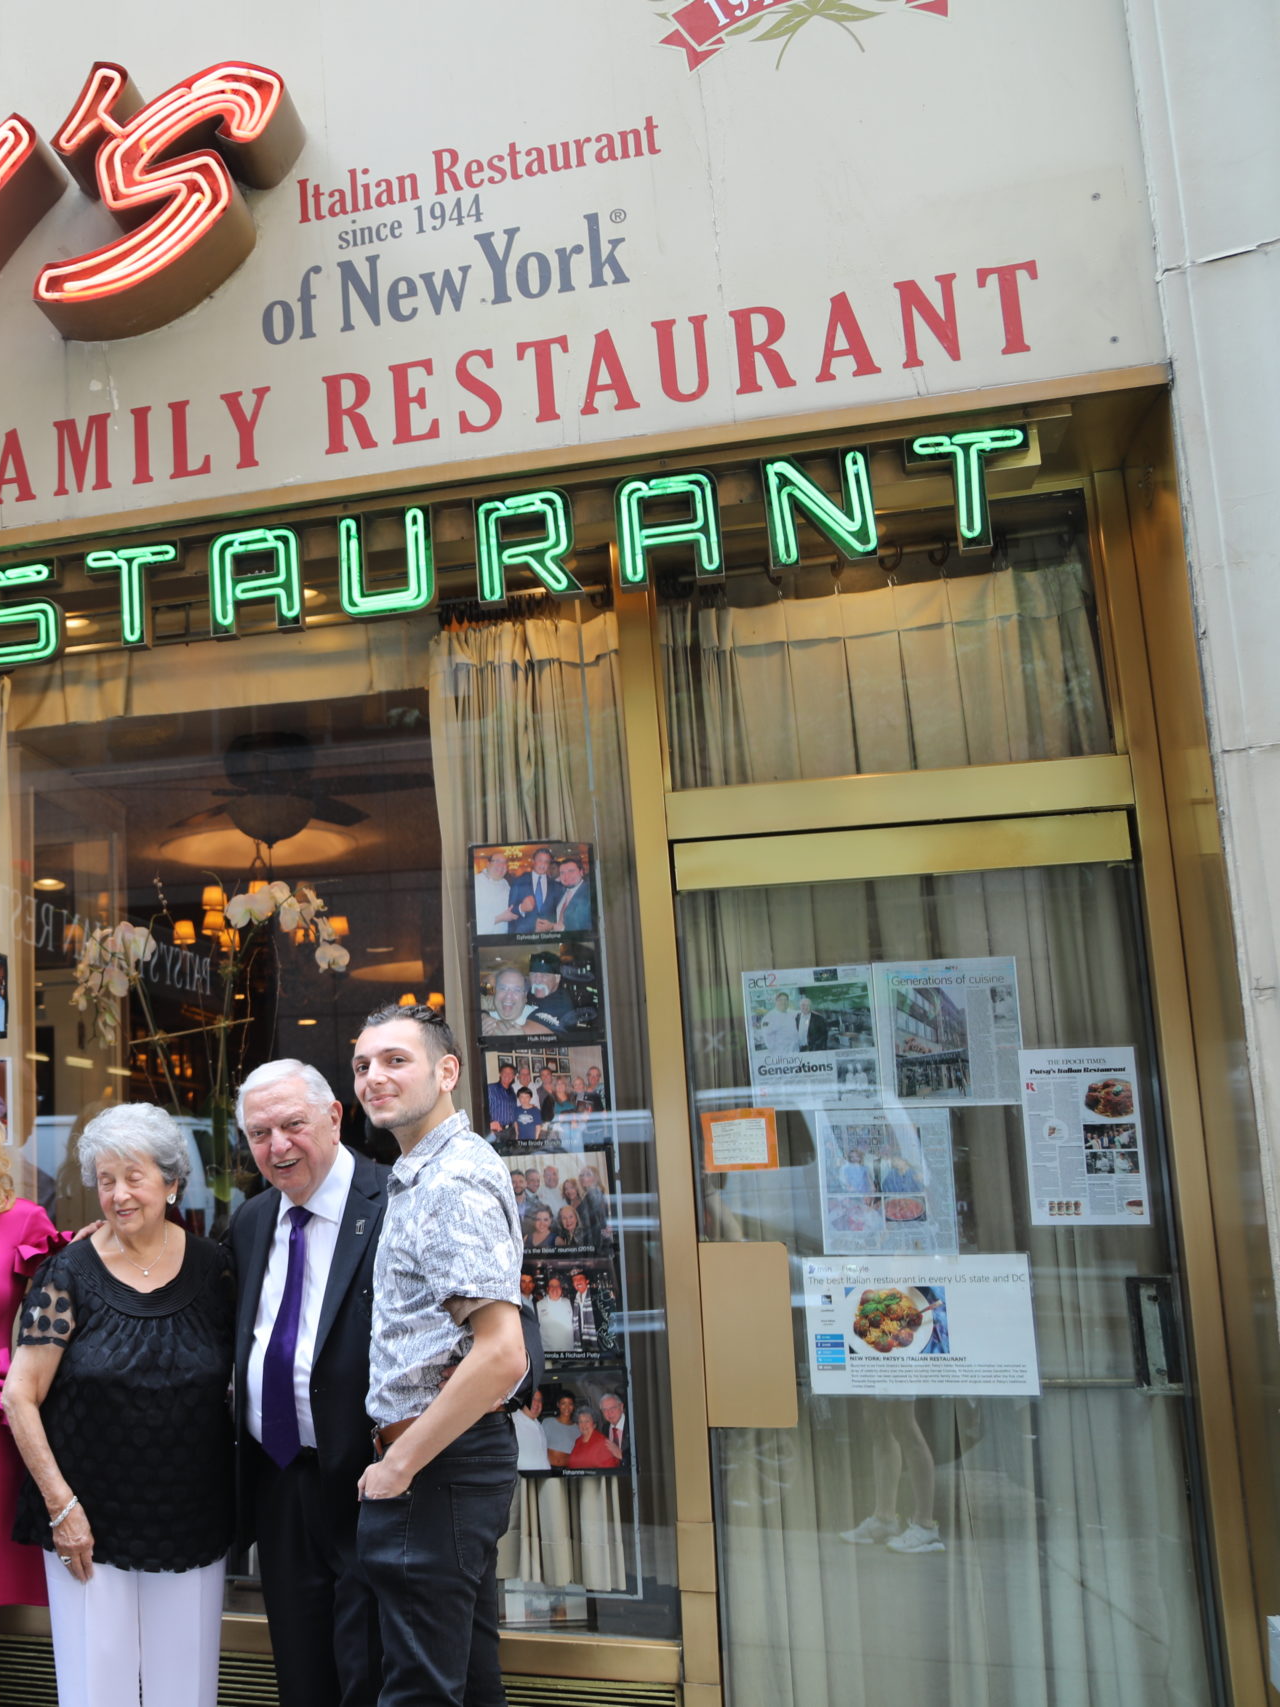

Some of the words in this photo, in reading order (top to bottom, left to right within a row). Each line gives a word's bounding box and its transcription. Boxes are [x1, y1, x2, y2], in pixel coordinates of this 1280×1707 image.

[297, 167, 419, 224] Italian
[432, 115, 662, 196] Restaurant
[338, 218, 403, 250] since
[414, 193, 484, 235] 1944
[262, 265, 323, 346] of
[337, 253, 472, 333] New
[321, 259, 1038, 456] RESTAURANT
[748, 973, 778, 990] act2
[891, 975, 953, 986] Generations
[955, 973, 966, 985] of
[969, 974, 1005, 984] cuisine
[764, 1055, 804, 1067] Culinary
[757, 1062, 834, 1077] Generations
[1057, 1067, 1082, 1075] Italian
[1083, 1066, 1127, 1074] Restaurant
[808, 1276, 824, 1285] The
[826, 1275, 844, 1285] best
[846, 1275, 871, 1285] Italian
[873, 1275, 917, 1284] restaurant
[919, 1275, 926, 1283] in
[928, 1276, 952, 1285] every
[954, 1275, 967, 1283] US
[969, 1275, 990, 1283] state
[992, 1274, 1009, 1283] and
[1012, 1274, 1025, 1282] DC
